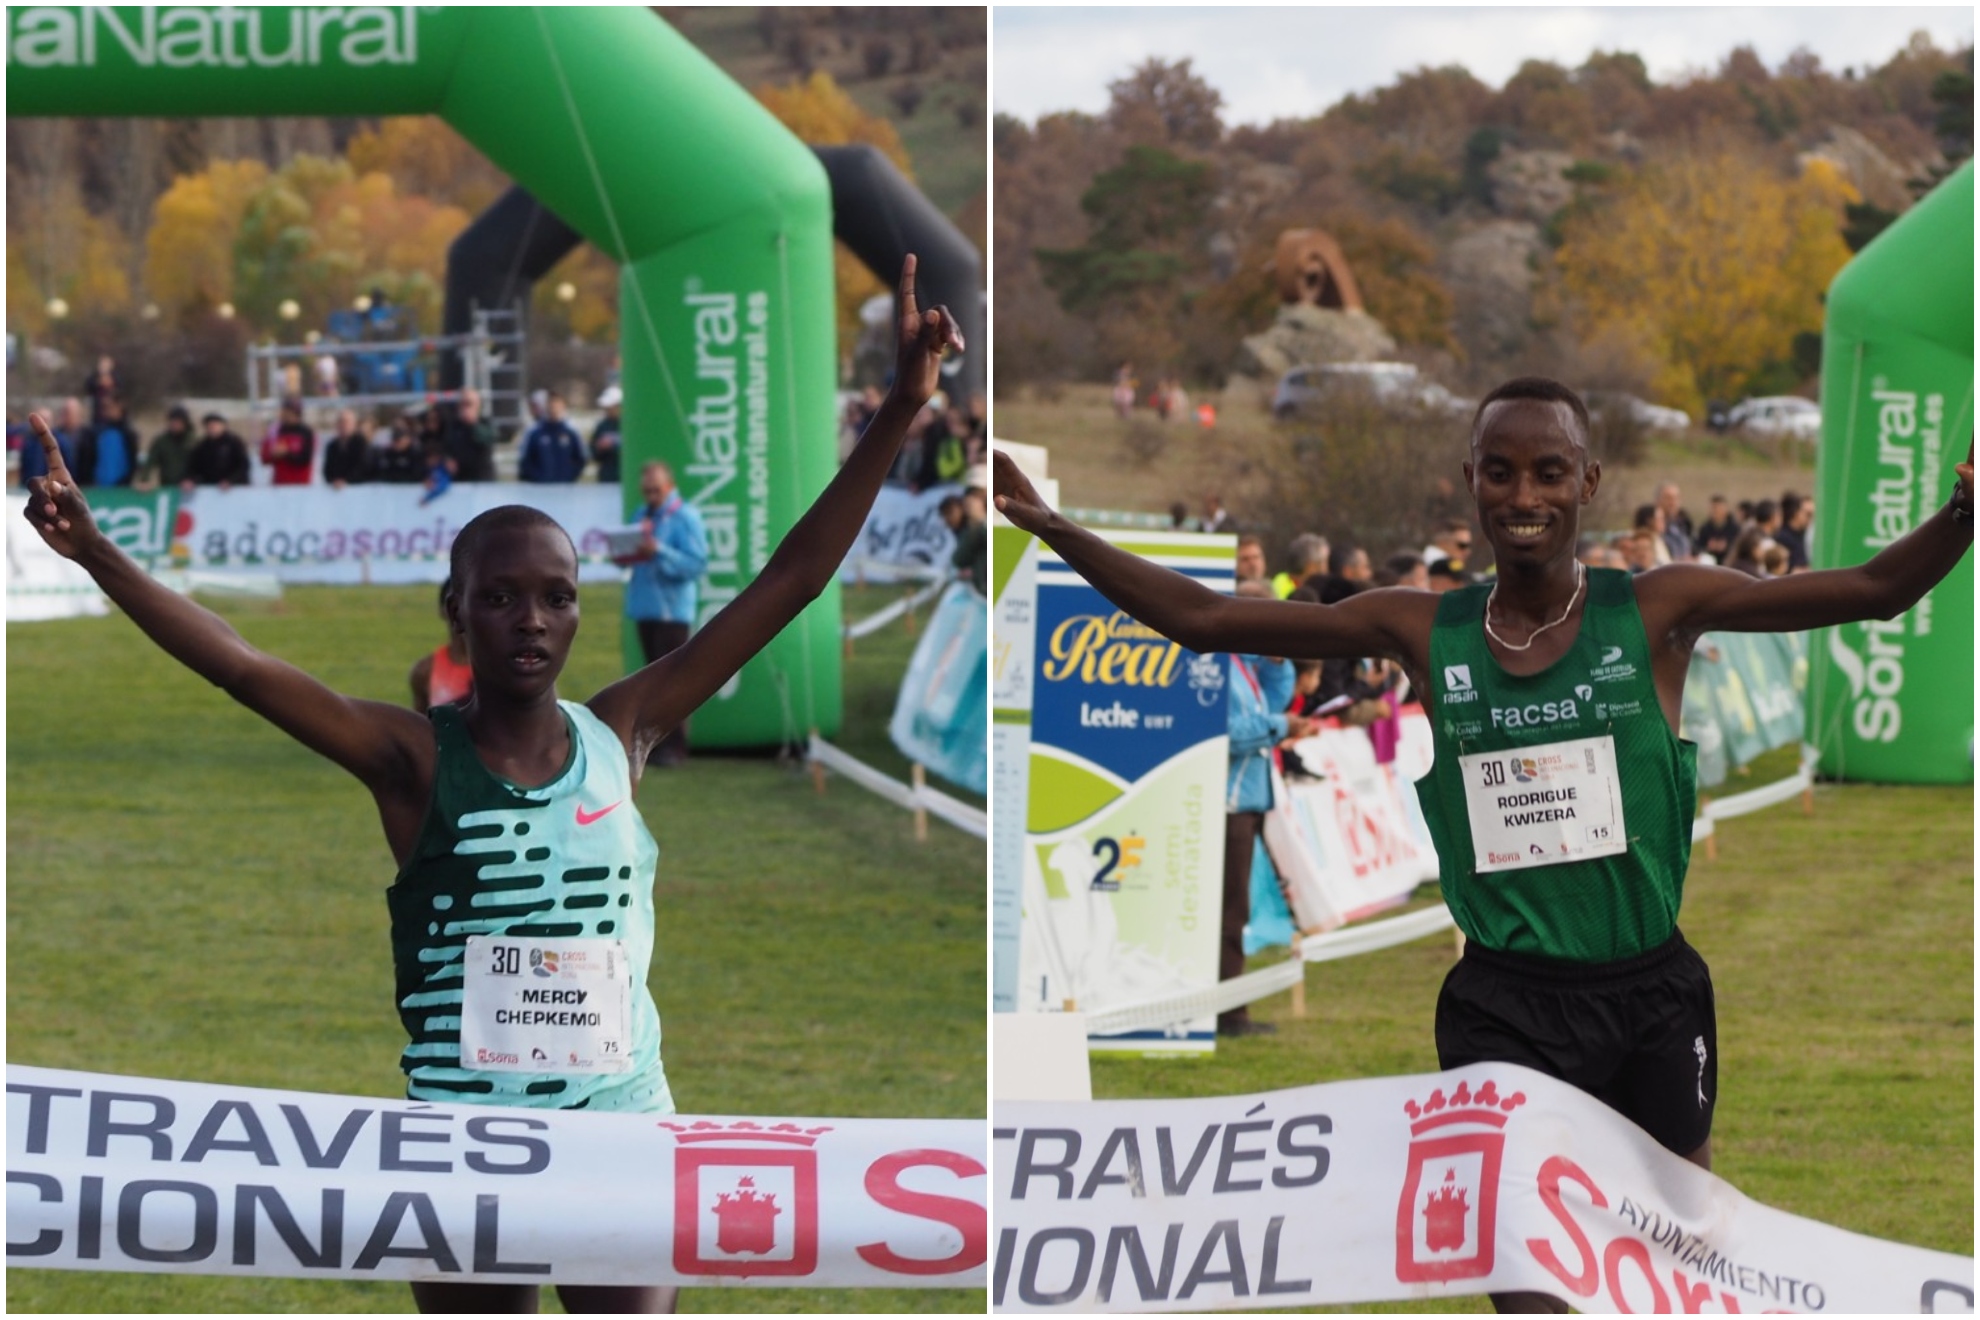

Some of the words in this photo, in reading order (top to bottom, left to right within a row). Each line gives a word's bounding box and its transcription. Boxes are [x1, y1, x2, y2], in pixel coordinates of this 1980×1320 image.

[1043, 615, 1184, 687] Real
[1080, 701, 1139, 728] Leche
[1481, 761, 1506, 786] 30
[1538, 755, 1562, 766] CROSS
[1497, 787, 1577, 809] RODRIGUE
[1504, 807, 1576, 827] KWIZERA
[1592, 827, 1608, 839] 15
[1164, 823, 1181, 890] semi
[1179, 783, 1203, 932] desnatada
[492, 946, 520, 974] 30
[495, 1010, 601, 1027] CHEPKEMOI
[604, 1042, 619, 1053] 75
[6, 1083, 551, 1175] TRAVÉS
[1618, 1196, 1826, 1310] AYUNTAMIENTO
